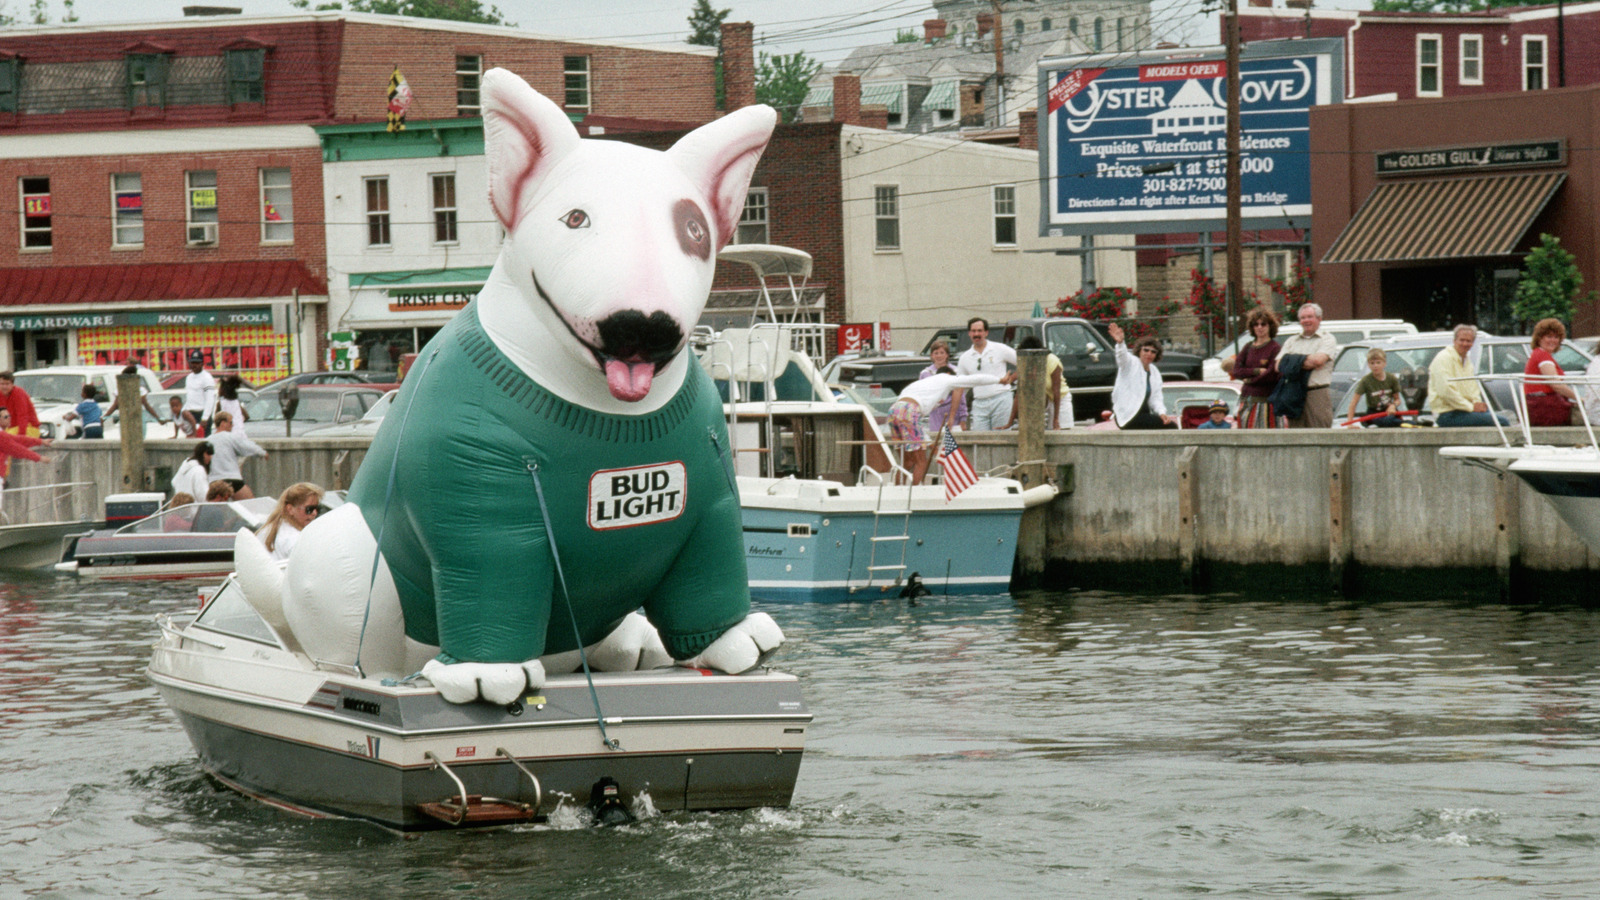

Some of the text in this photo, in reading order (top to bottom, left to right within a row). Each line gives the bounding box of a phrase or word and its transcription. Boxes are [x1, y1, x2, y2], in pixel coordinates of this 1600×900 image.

[1145, 64, 1218, 77] MODELS OPEN
[1064, 80, 1167, 133] OYSTER
[1081, 135, 1291, 158] Exquisite Waterfront Ridences
[1399, 152, 1446, 167] GOLDEN
[1450, 150, 1479, 164] GULL
[1096, 162, 1144, 178] Prices
[1186, 160, 1202, 175] at
[1206, 157, 1274, 174] $17,000
[1142, 177, 1227, 193] 301-827-7500
[1068, 197, 1117, 208] Directions:
[1119, 197, 1137, 207] 2nd
[1140, 195, 1162, 208] right
[1164, 195, 1187, 205] after
[1188, 194, 1212, 204] Kent
[1254, 191, 1288, 205] Bridge
[396, 292, 437, 308] IRISH
[19, 314, 114, 329] HARDWARE
[157, 314, 196, 324] PAINT
[229, 313, 269, 324] TOOLS
[611, 470, 670, 497] BUD
[596, 490, 680, 521] LIGHT
